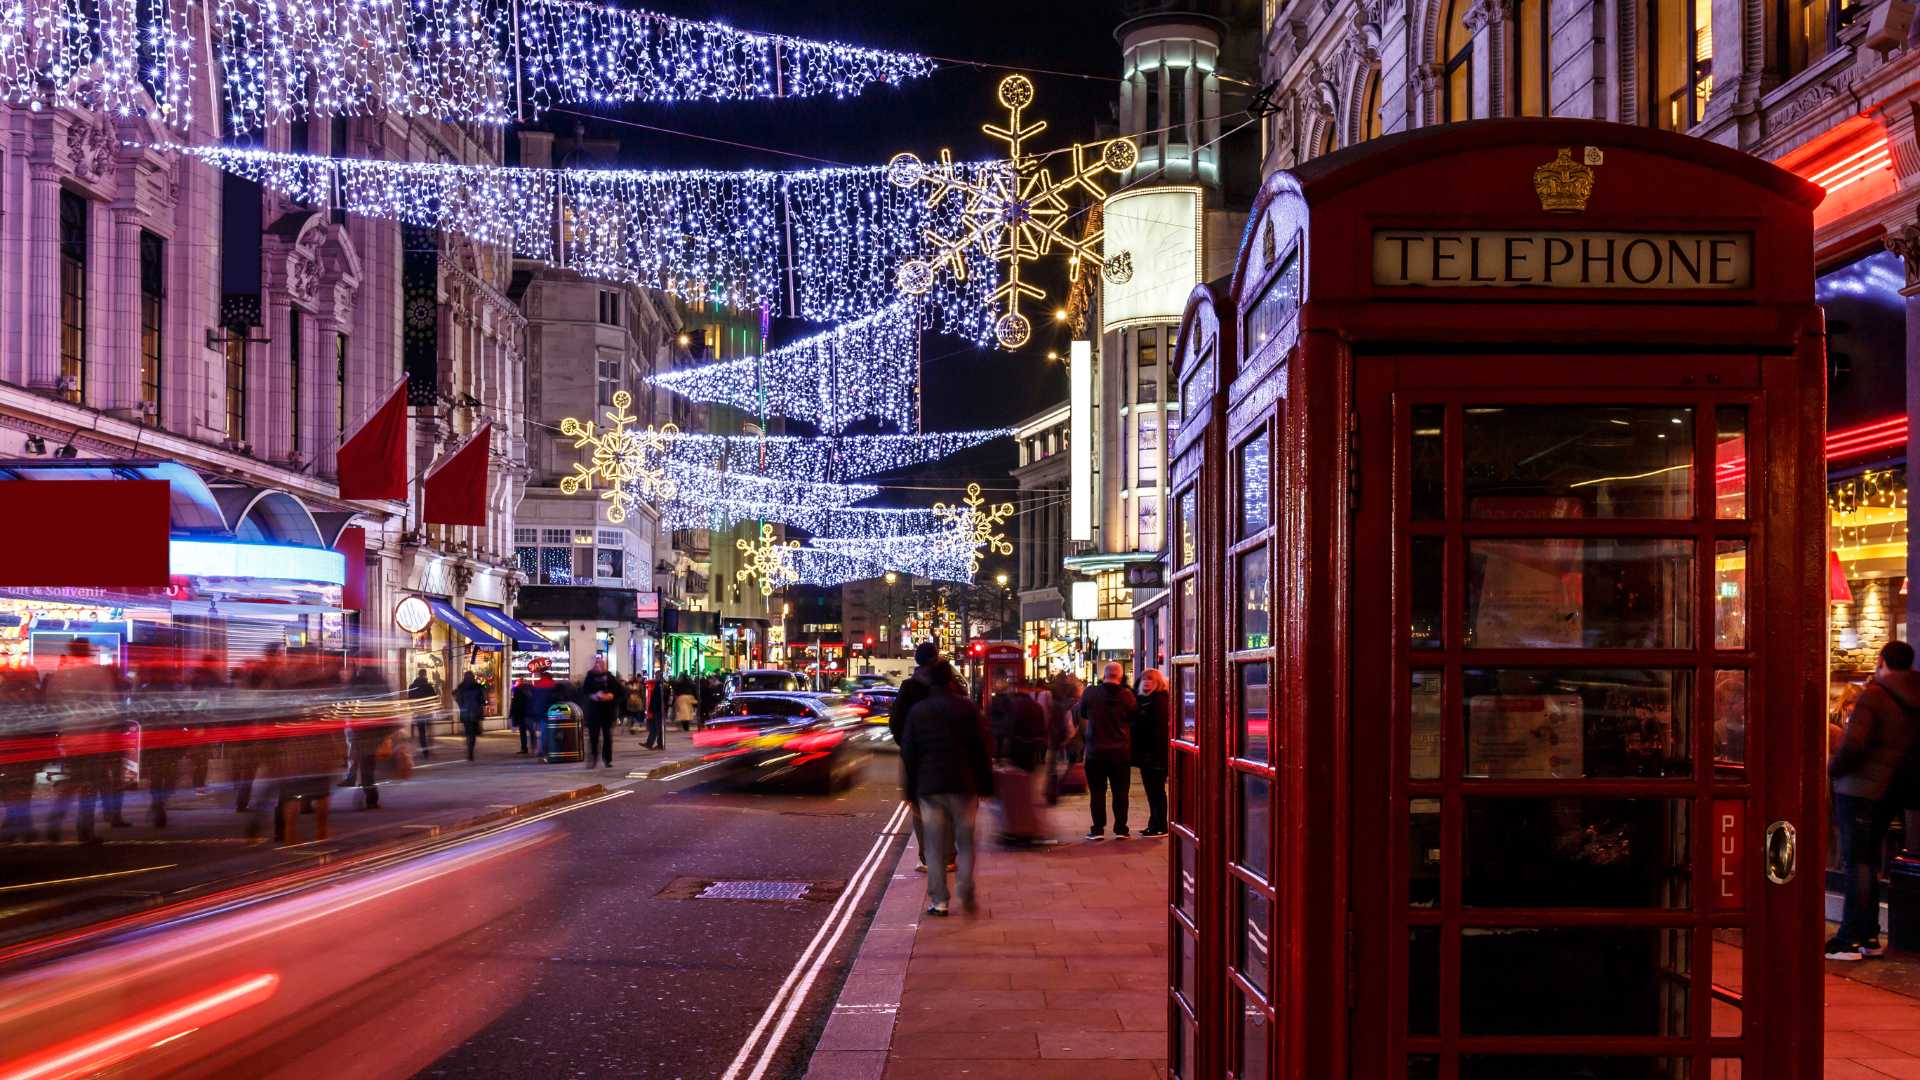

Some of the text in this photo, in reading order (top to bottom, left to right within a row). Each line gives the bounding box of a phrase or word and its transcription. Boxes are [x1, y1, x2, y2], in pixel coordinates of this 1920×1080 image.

[1385, 236, 1737, 285] TELEPHONE
[46, 586, 107, 598] Souvenir
[528, 659, 552, 671] SALE
[1721, 814, 1735, 897] PULL
